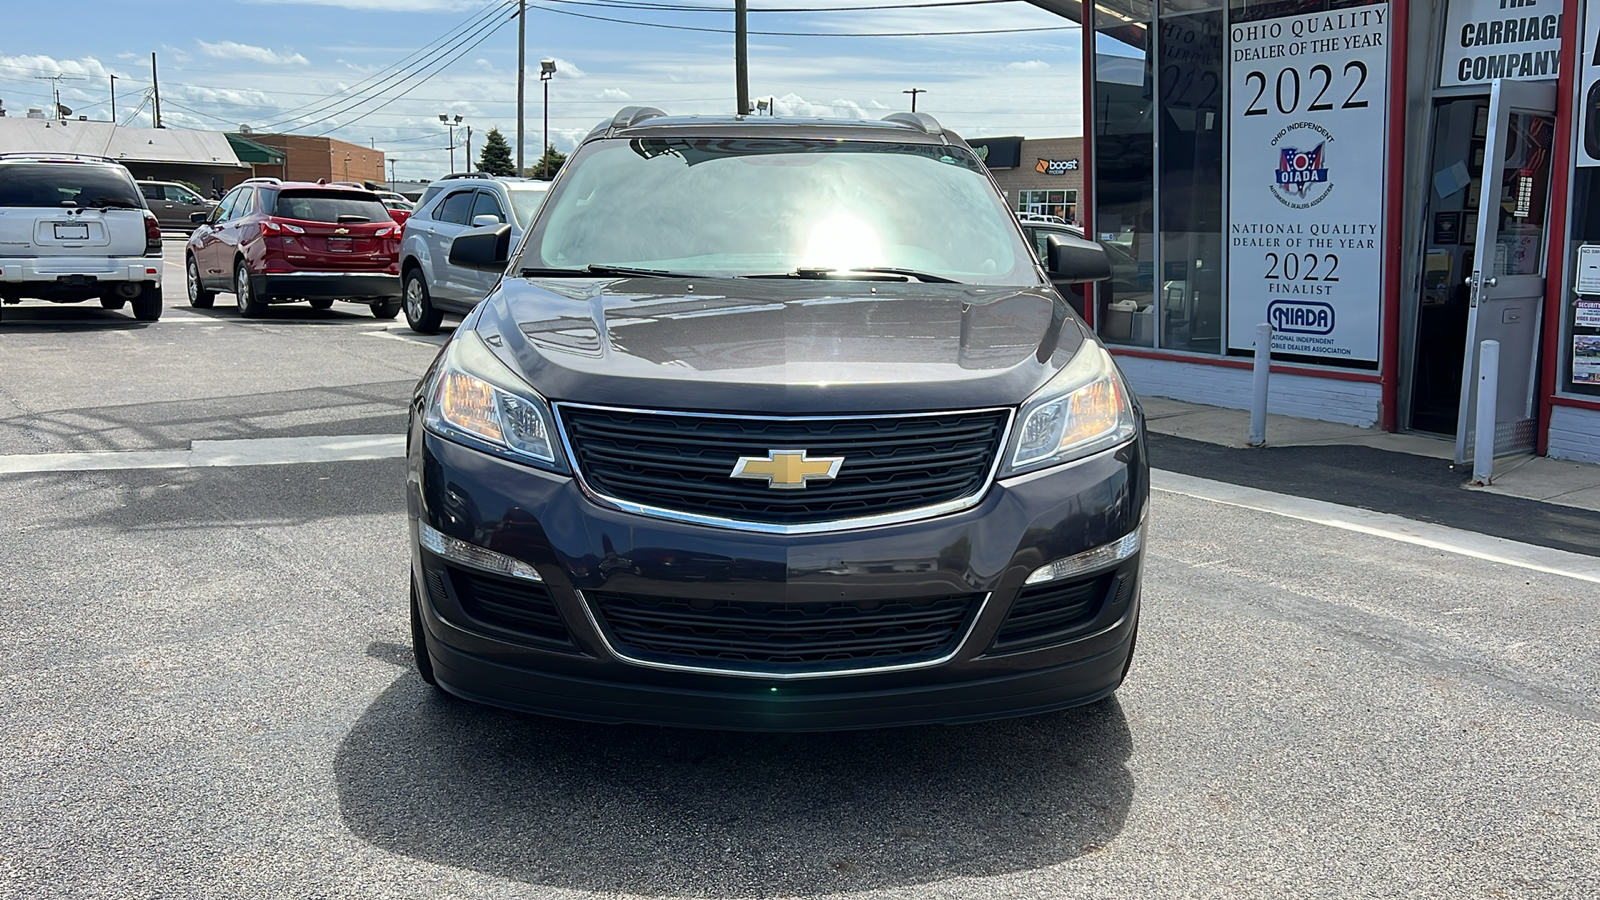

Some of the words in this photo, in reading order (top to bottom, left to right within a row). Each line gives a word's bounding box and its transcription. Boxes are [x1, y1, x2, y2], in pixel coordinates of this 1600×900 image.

[1232, 22, 1282, 43] OHIO
[1291, 8, 1387, 38] QUALITY
[1234, 44, 1285, 62] DEALER
[1289, 42, 1307, 56] OF
[1310, 37, 1340, 54] THE
[1343, 32, 1383, 49] YEAR
[1457, 50, 1561, 81] COMPANY
[1243, 60, 1369, 117] 2022
[1270, 128, 1287, 146] OHIO
[1286, 121, 1335, 143] INDEPENDENT
[1049, 159, 1077, 170] boost
[1281, 170, 1319, 183] OIADA
[1268, 185, 1291, 208] AUTOMOBILE
[1290, 202, 1310, 210] DEALERS
[1310, 182, 1334, 207] ASSOCIATION
[1232, 223, 1303, 234] NATIONAL
[1310, 223, 1378, 236] QUALITY
[1233, 237, 1280, 247] DEALER
[1286, 238, 1302, 248] OF
[1307, 238, 1333, 248] THE
[1339, 239, 1375, 249] YEAR
[1264, 252, 1340, 282] 2022
[1268, 283, 1333, 295] FINALIST
[1272, 306, 1328, 329] NIADA
[1271, 334, 1295, 342] ATIONAL
[1295, 336, 1335, 345] INDEPENDENT
[1287, 343, 1311, 352] DEALERS
[1311, 346, 1351, 355] ASSOCIATION
